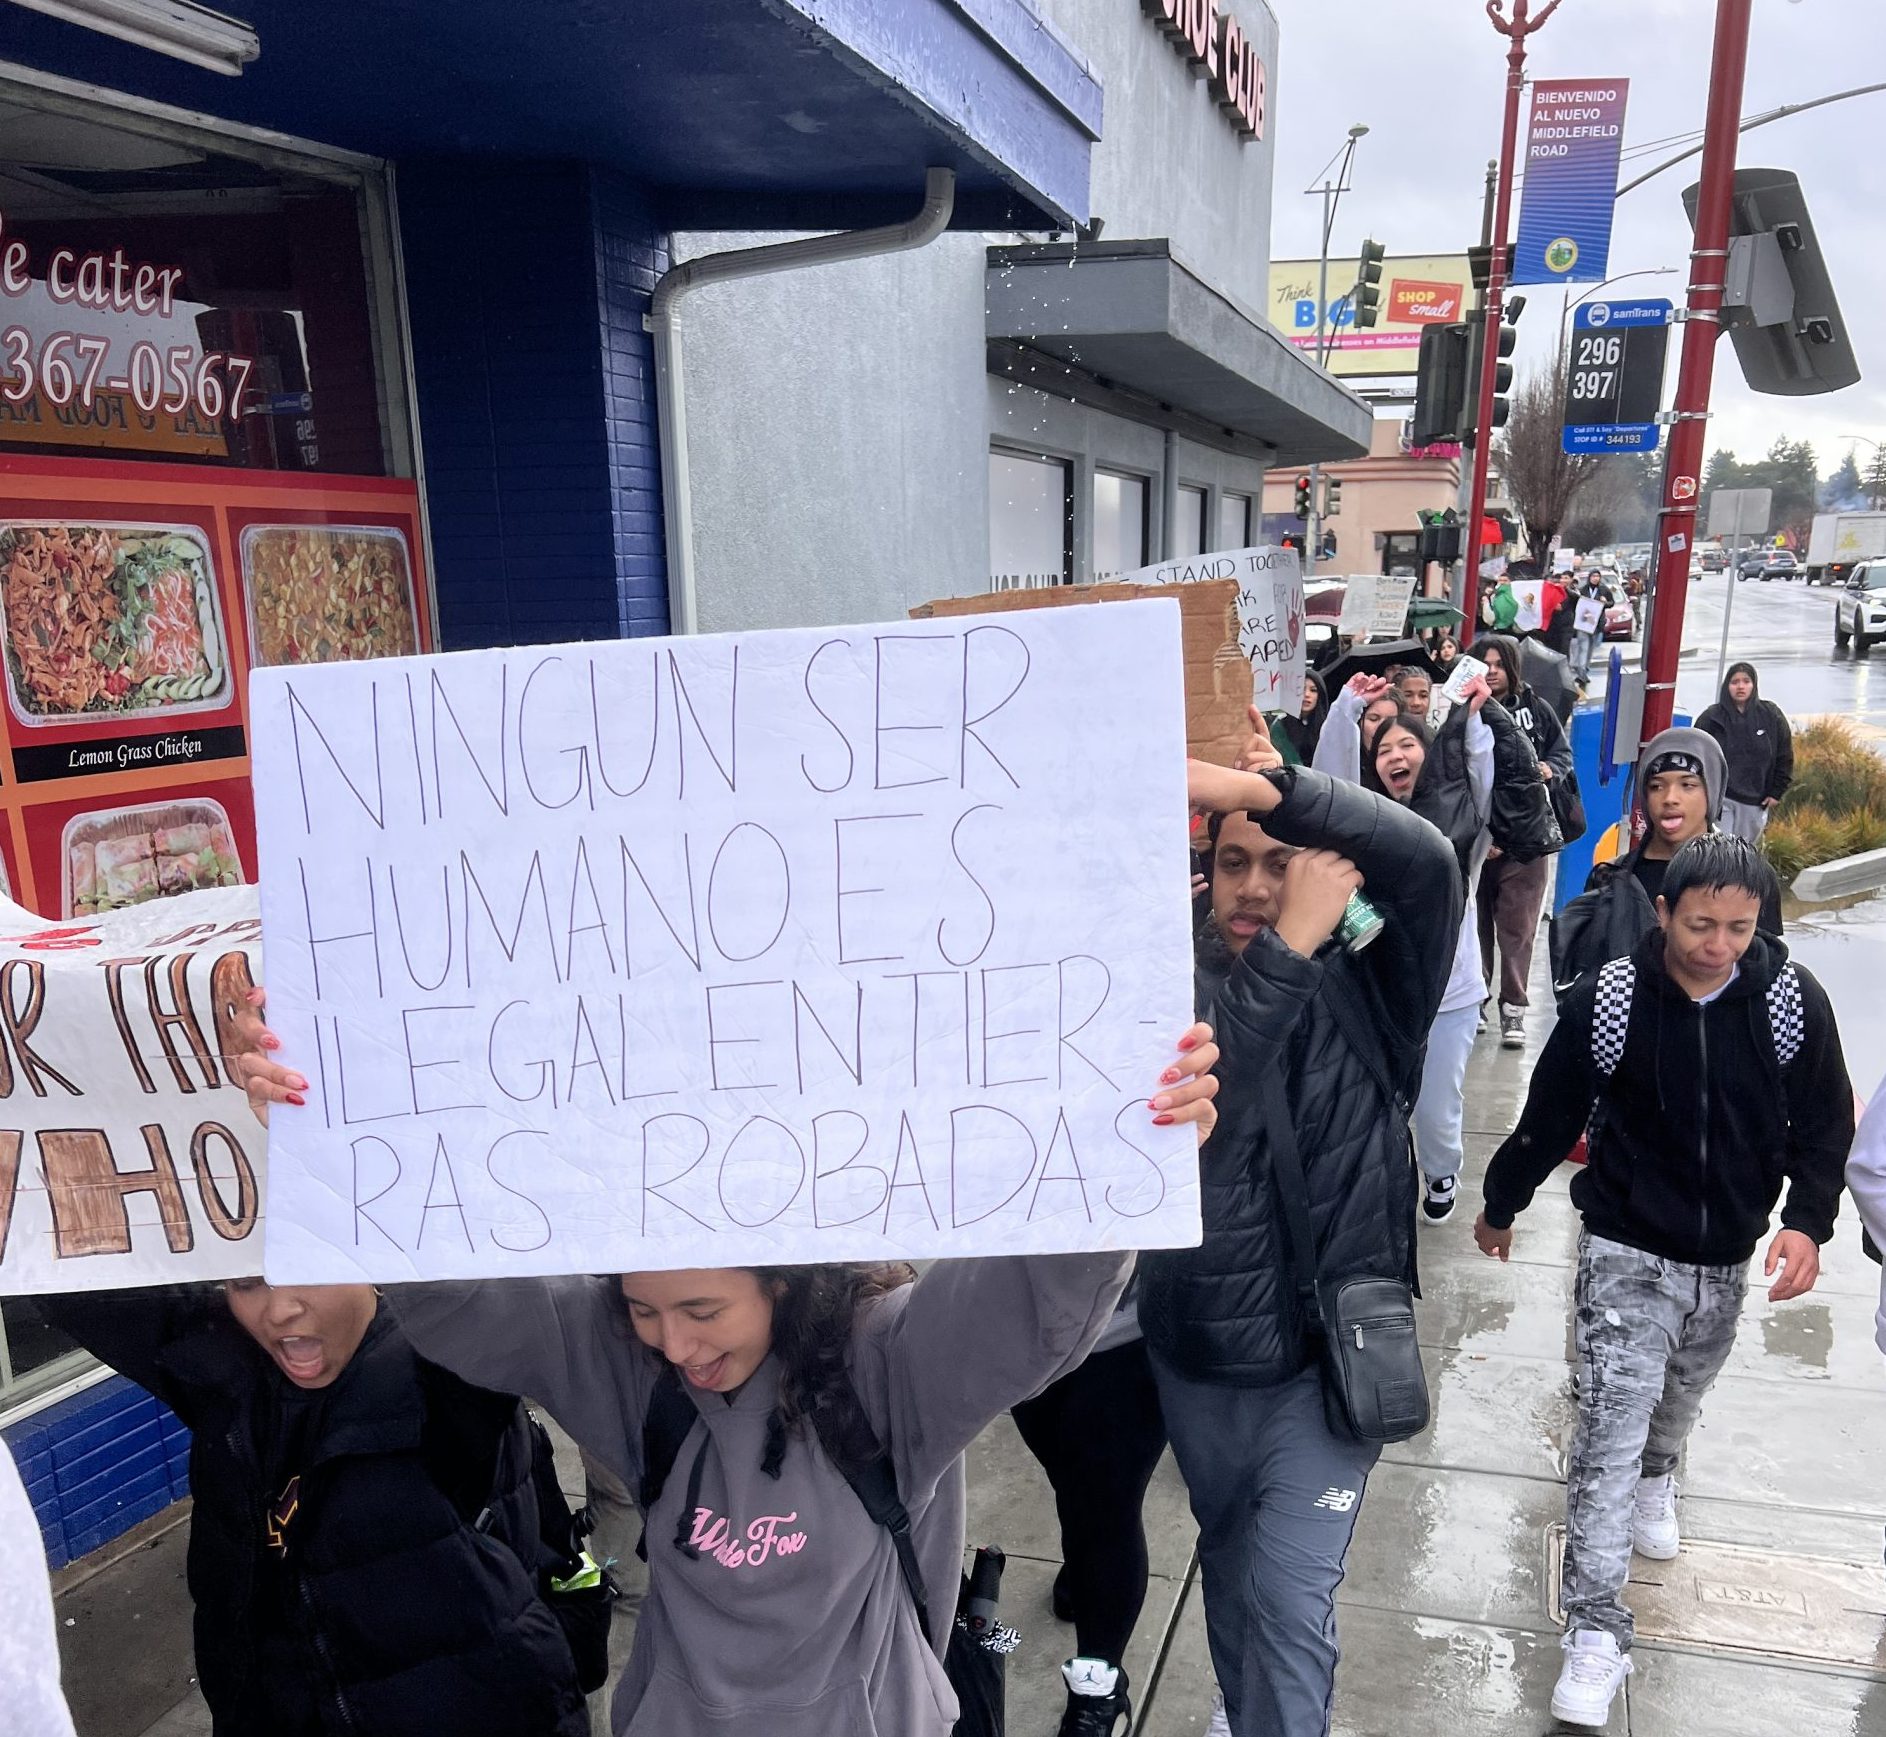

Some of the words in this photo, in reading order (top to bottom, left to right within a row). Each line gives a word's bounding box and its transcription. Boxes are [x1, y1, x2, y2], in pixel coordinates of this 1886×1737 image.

[1225, 14, 1266, 141] CLUB
[1536, 90, 1616, 104] BIENVENIDO
[1534, 110, 1551, 121] AL
[1554, 108, 1600, 121] NUEVO
[1532, 125, 1618, 139] MIDDLEFIELD
[1530, 145, 1568, 157] ROAD
[49, 248, 182, 314] cater
[1294, 297, 1356, 327] BG
[1397, 291, 1435, 304] SHOP
[1408, 300, 1454, 317] small
[1613, 307, 1661, 319] samTrans
[1578, 337, 1620, 366] 296
[3, 329, 252, 421] 367-0567
[1573, 371, 1613, 399] 397
[1606, 434, 1641, 444] 344193
[286, 647, 737, 834] NINGUN
[801, 626, 1030, 793] SER
[68, 749, 114, 768] Lemon
[117, 743, 152, 767] Grass
[155, 735, 202, 759] Chicken
[298, 822, 790, 1000] HUMANO
[835, 804, 1003, 967] ES
[314, 994, 679, 1129] ILEGAL
[706, 980, 863, 1095] EN
[350, 1130, 552, 1254] RAS
[641, 1098, 1165, 1236] ROBADAS
[746, 1511, 808, 1568] Fox
